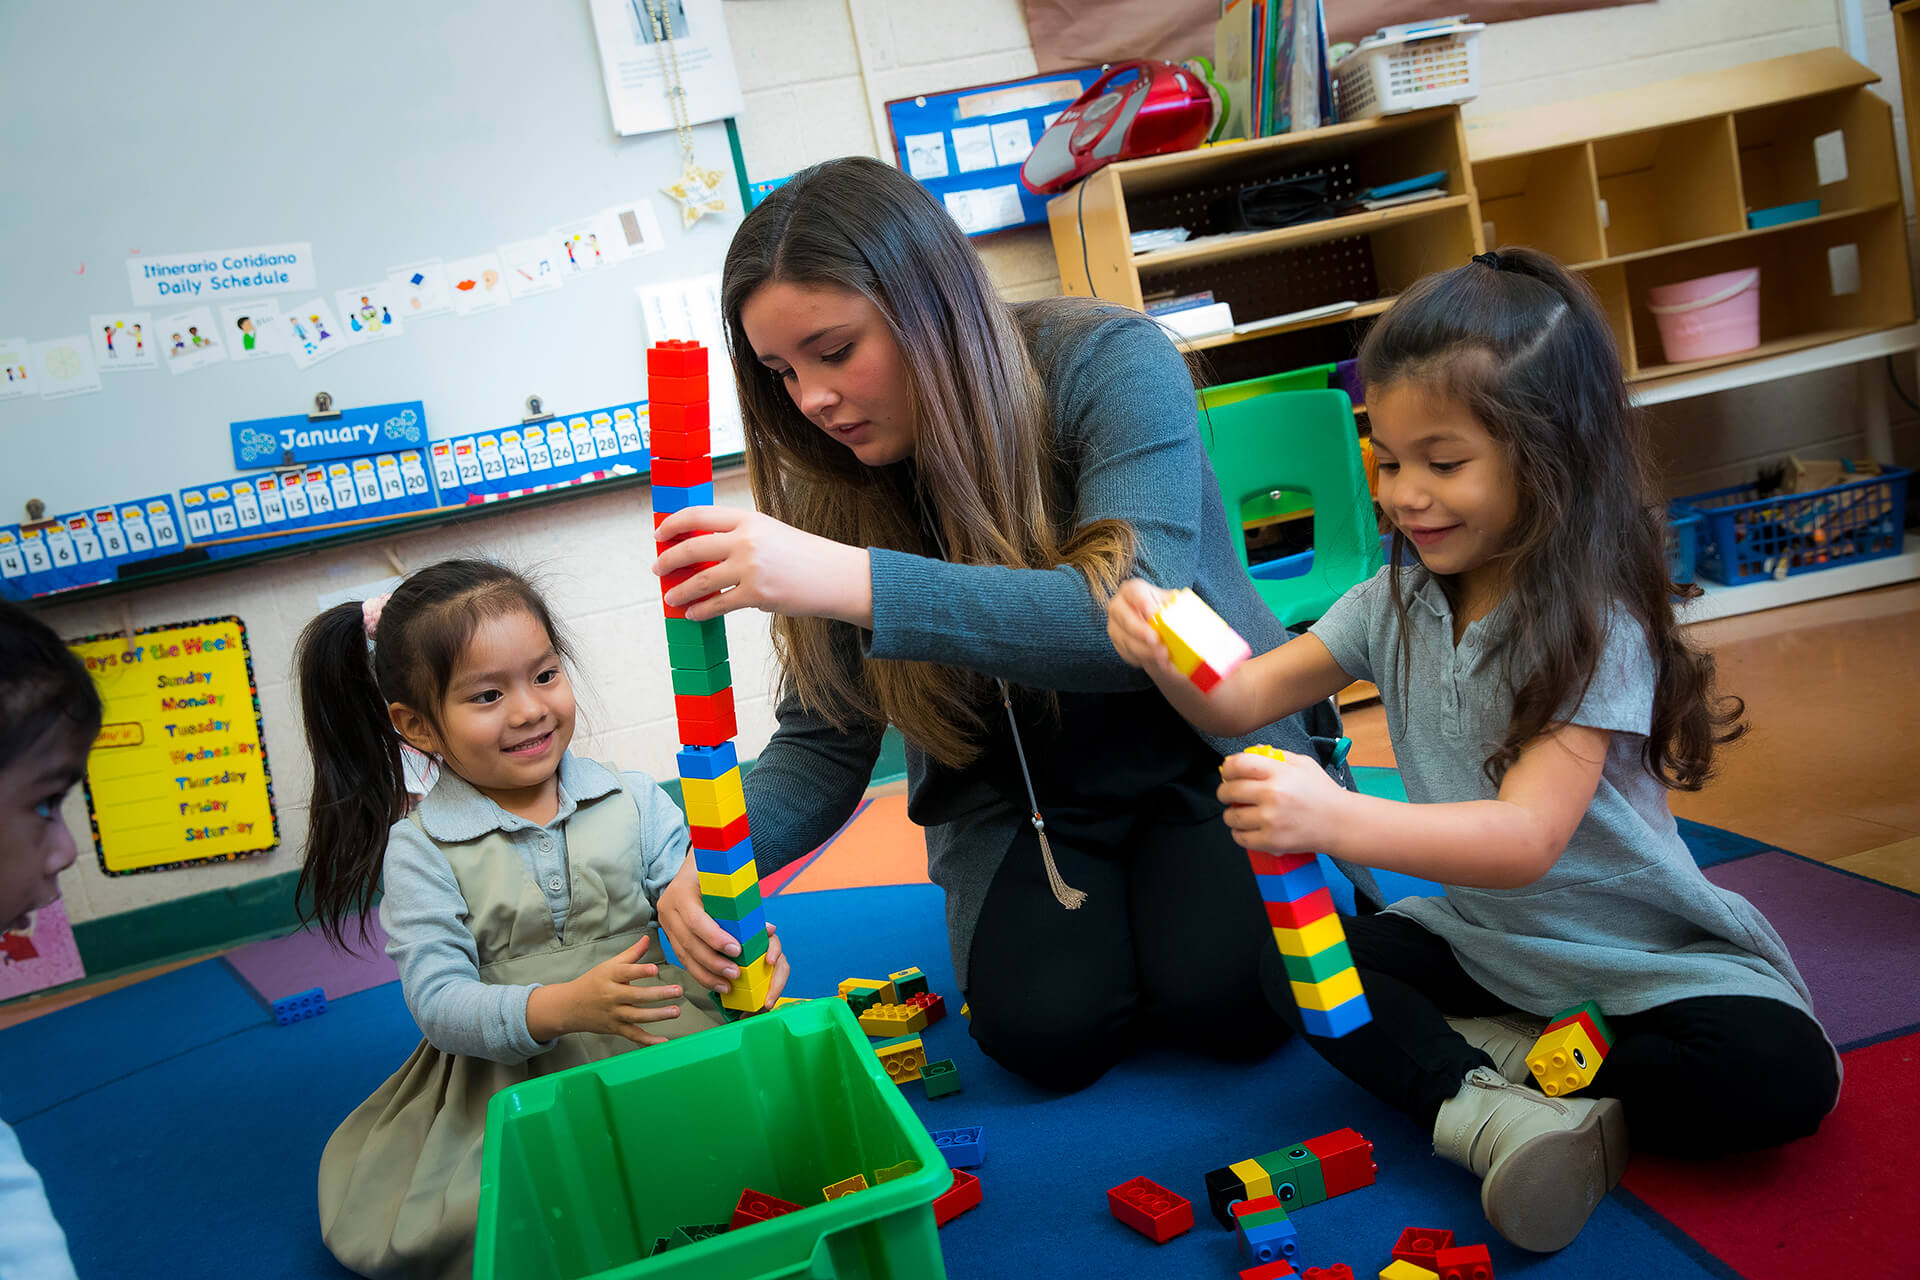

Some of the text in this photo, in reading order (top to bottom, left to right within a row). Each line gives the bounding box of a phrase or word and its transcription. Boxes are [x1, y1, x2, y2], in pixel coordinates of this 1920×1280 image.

[143, 253, 297, 279] Itinerario Cotidiano
[157, 270, 289, 296] Daily Schedule
[279, 422, 380, 450] January
[440, 430, 650, 483] 21 22 23 24 25 26 27 28 29 3
[194, 473, 425, 531] 11 12 13 14 15 16 17 18 19 20
[5, 526, 173, 570] 4 5 6 7 8 9 10
[85, 634, 236, 673] ays of the Week
[156, 671, 213, 689] Sunday
[161, 692, 225, 713] Monday
[164, 718, 231, 738] Tuesday
[169, 742, 256, 766] Wednesday
[175, 769, 247, 791] Thursday
[179, 799, 229, 816] Friday
[184, 820, 256, 842] Saturday
